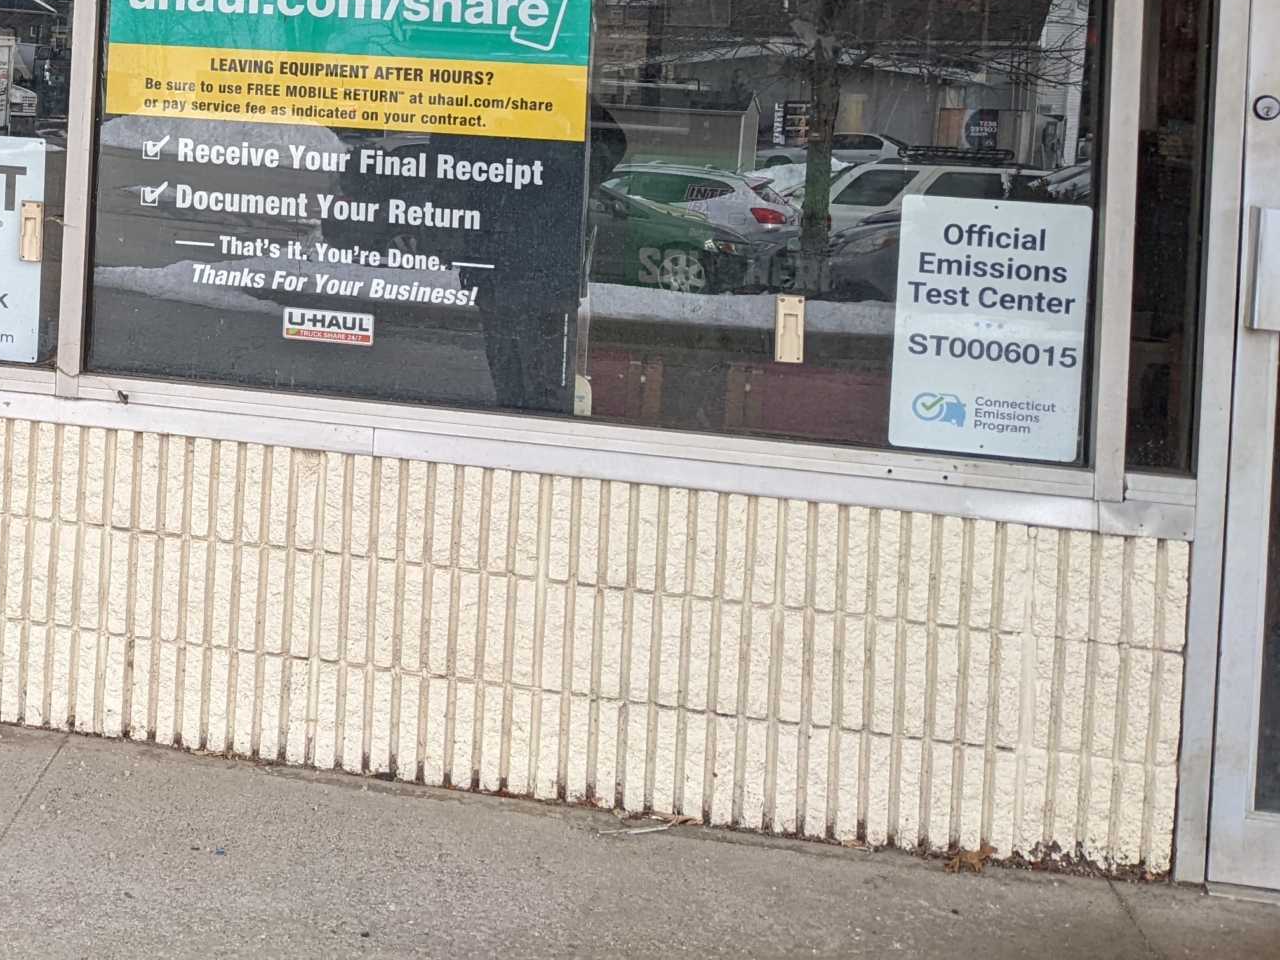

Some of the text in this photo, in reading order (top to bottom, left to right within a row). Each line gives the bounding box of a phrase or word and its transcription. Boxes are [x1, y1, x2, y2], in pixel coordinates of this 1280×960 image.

[210, 58, 494, 85] LEAVING EQUIPMENT AFTER HOURS?
[145, 77, 162, 90] Be
[166, 81, 196, 92] sure
[200, 80, 213, 93] to
[218, 84, 242, 95] use
[246, 83, 280, 97] FREE
[285, 84, 338, 101] MOBILE
[409, 92, 423, 105] at
[428, 93, 553, 112] uhaul.com/share
[144, 98, 486, 128] or pay service fee as indicated on your contract.
[177, 138, 544, 190] Receive Your Final Receipt
[176, 184, 481, 230] Document Your Return
[943, 223, 1047, 252] Official
[220, 236, 281, 259] That's
[285, 238, 308, 260] it.
[388, 248, 448, 271] Done.
[918, 251, 1068, 283] Emissions
[192, 264, 478, 306] Thanks For Your Business!
[908, 280, 1076, 315] Test Center
[288, 311, 370, 332] U-HAUL
[300, 329, 322, 337] TRUCK
[323, 332, 346, 340] SHARE
[907, 333, 1078, 369] ST0006015
[974, 408, 1040, 424] Emissions
[975, 396, 1056, 413] Connecticut
[973, 419, 1031, 435] Program
